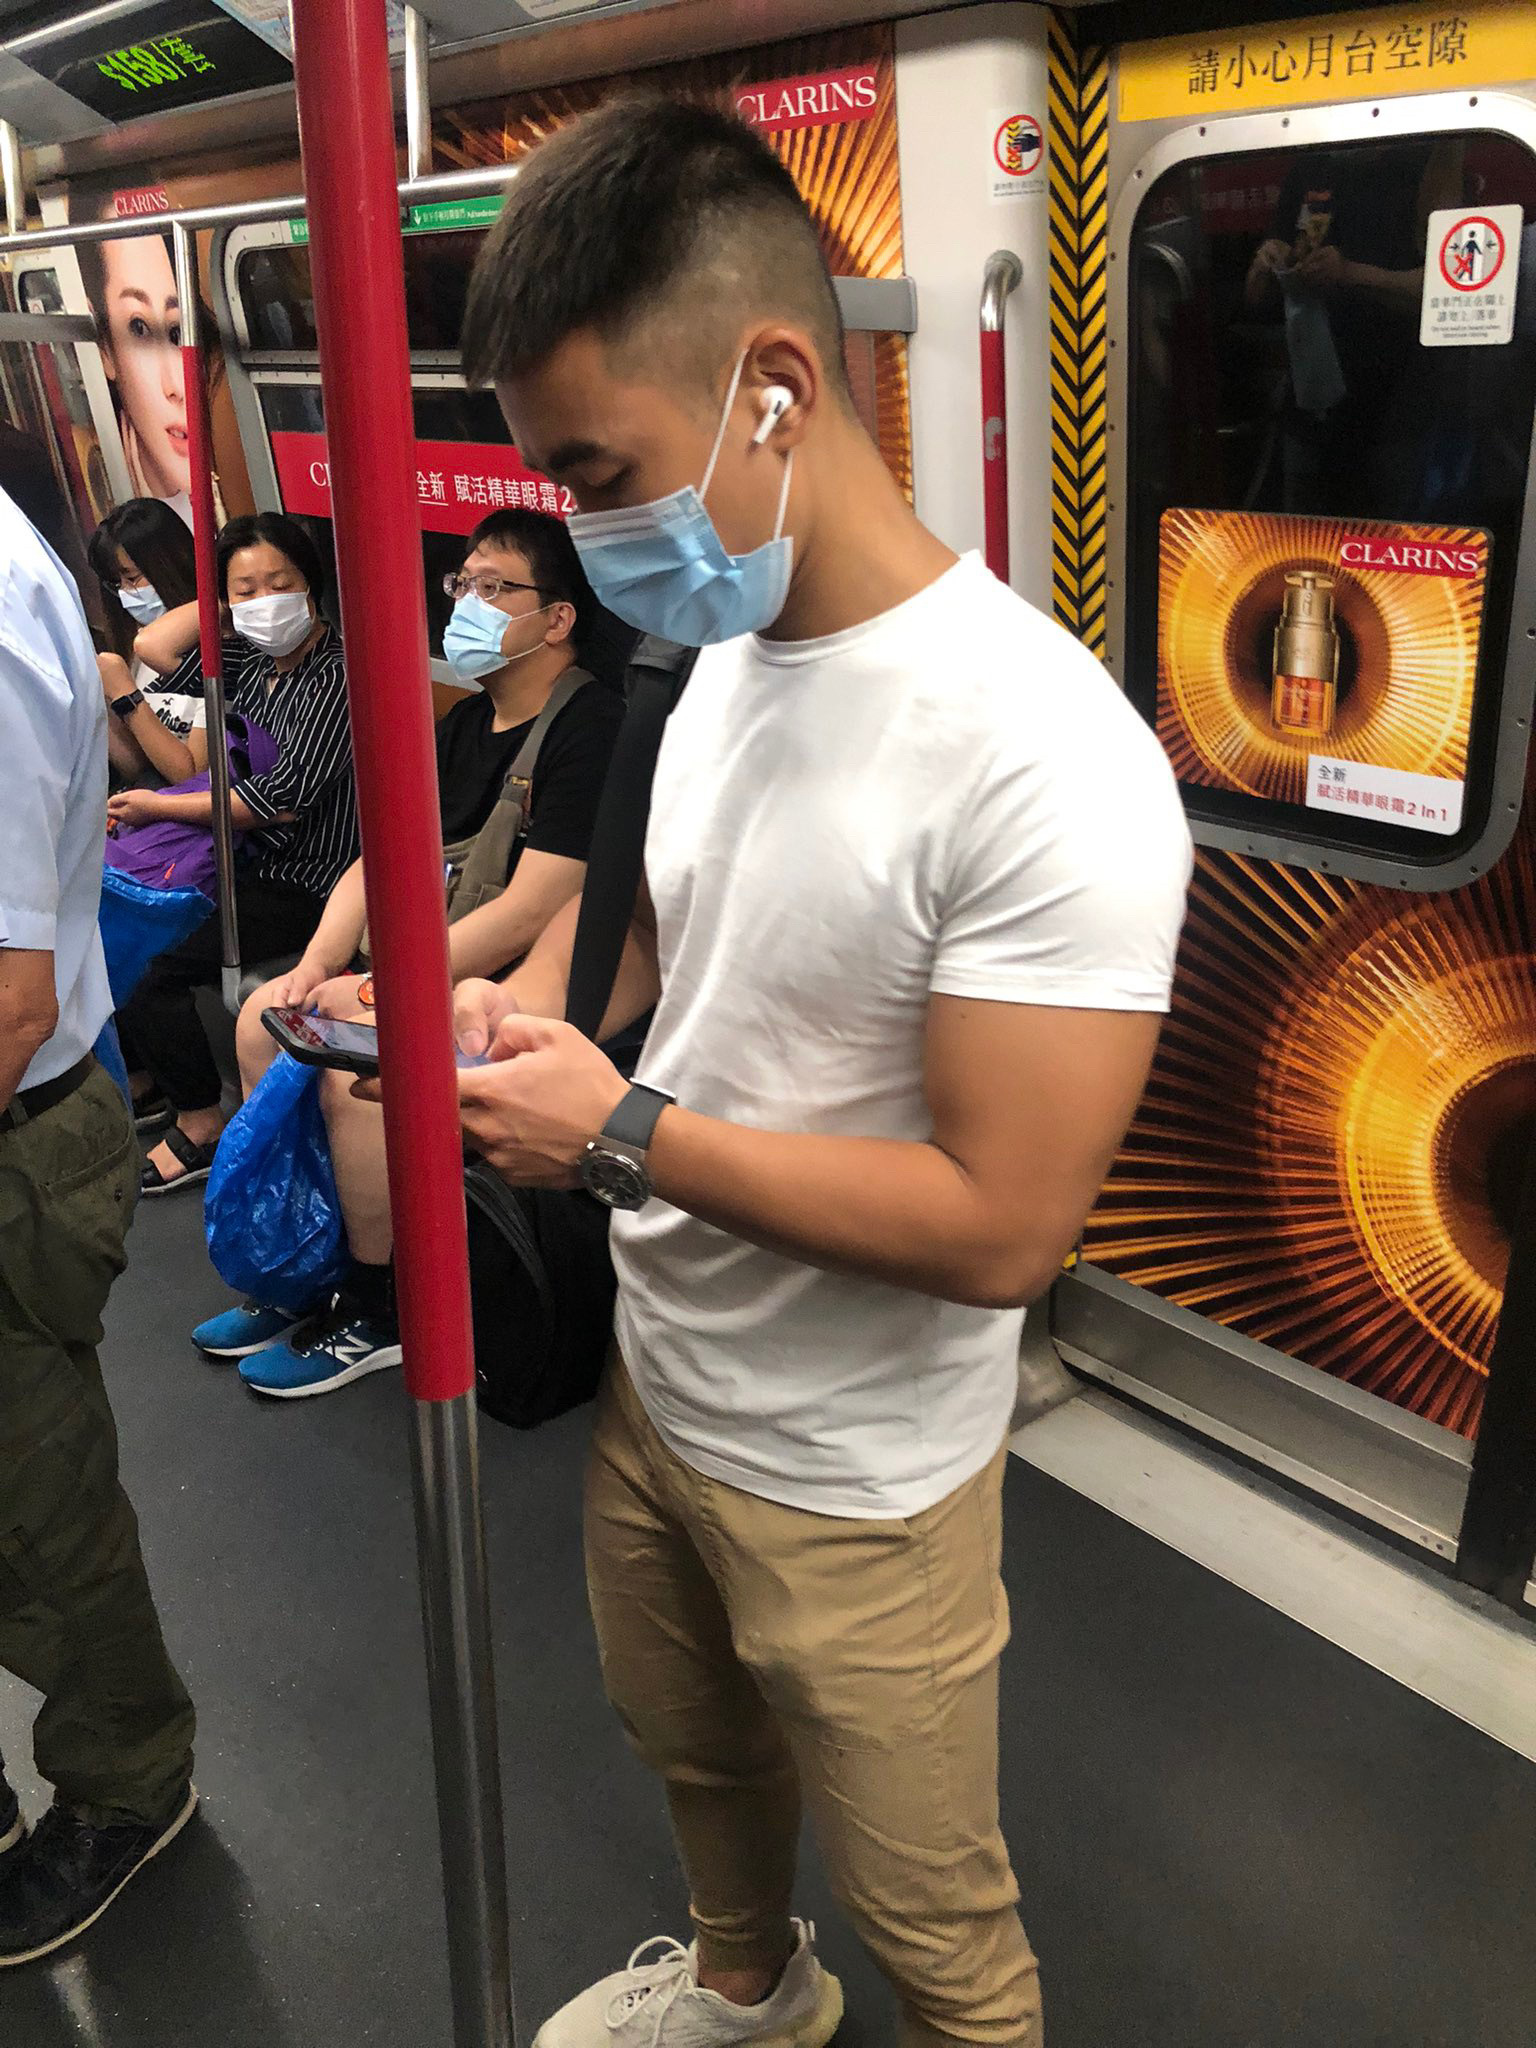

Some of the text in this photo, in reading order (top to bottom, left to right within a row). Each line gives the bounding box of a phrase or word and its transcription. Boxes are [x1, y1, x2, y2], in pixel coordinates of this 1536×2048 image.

[1188, 16, 1469, 95] 請小心月台空隙
[736, 75, 878, 124] CLARINS
[114, 191, 169, 216] CLARINS
[416, 470, 446, 501] 全新
[1340, 542, 1479, 573] CLARINS
[1317, 765, 1347, 783] 全新
